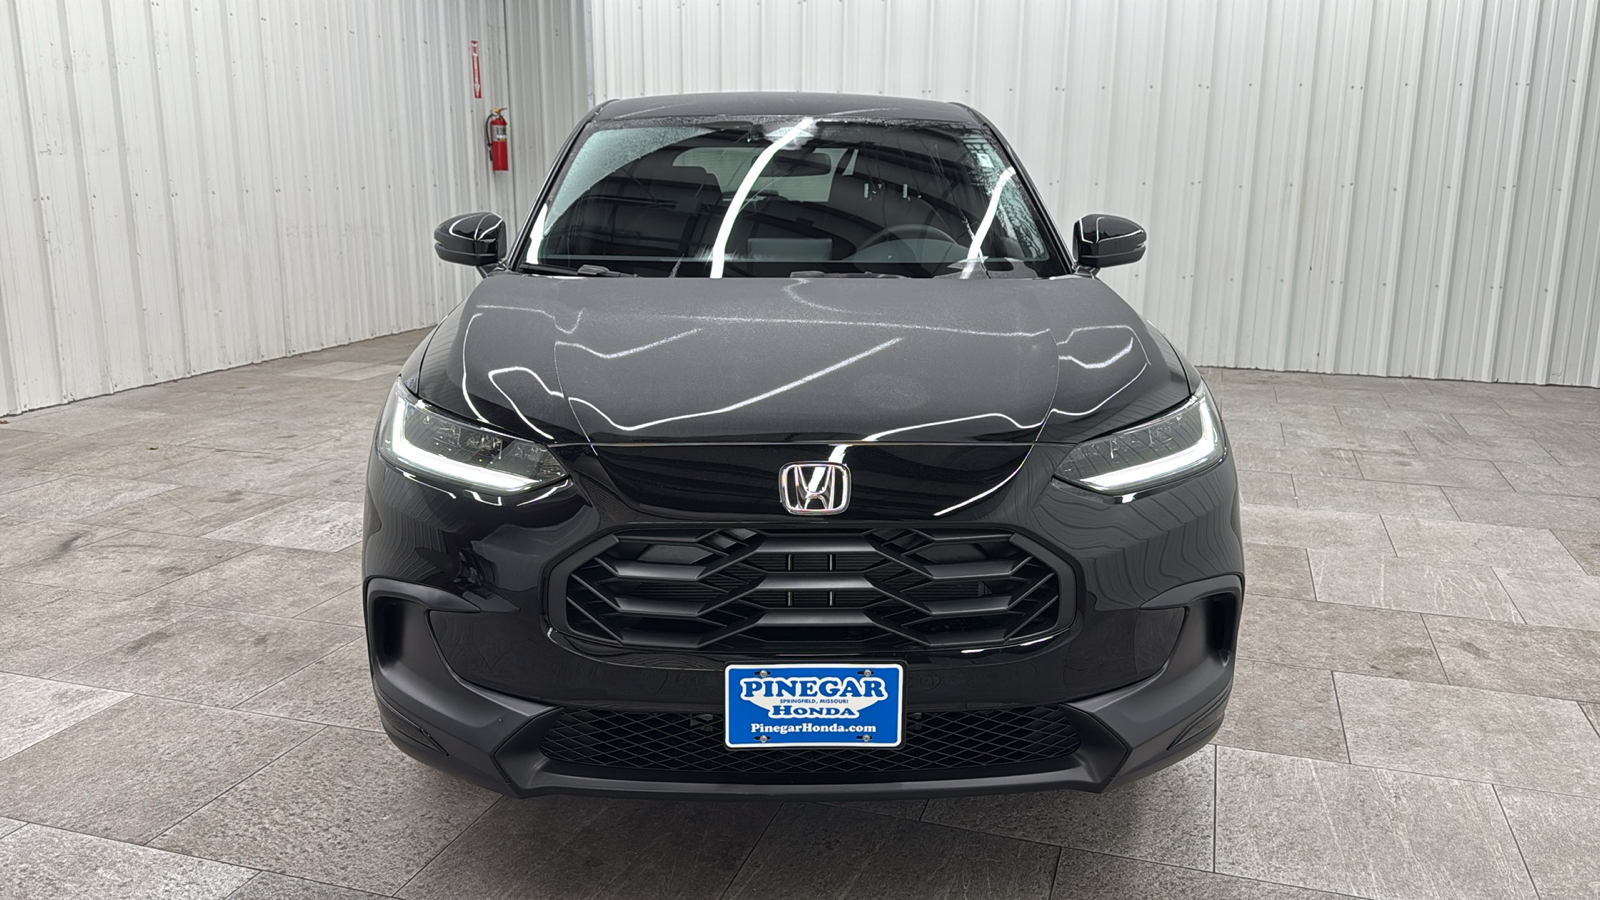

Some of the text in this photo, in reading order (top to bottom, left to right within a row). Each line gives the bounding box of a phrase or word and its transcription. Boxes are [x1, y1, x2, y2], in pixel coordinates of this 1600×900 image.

[743, 680, 886, 698] PINEGAR
[771, 705, 856, 716] HONDA
[750, 723, 877, 735] PinegarHonda.com
